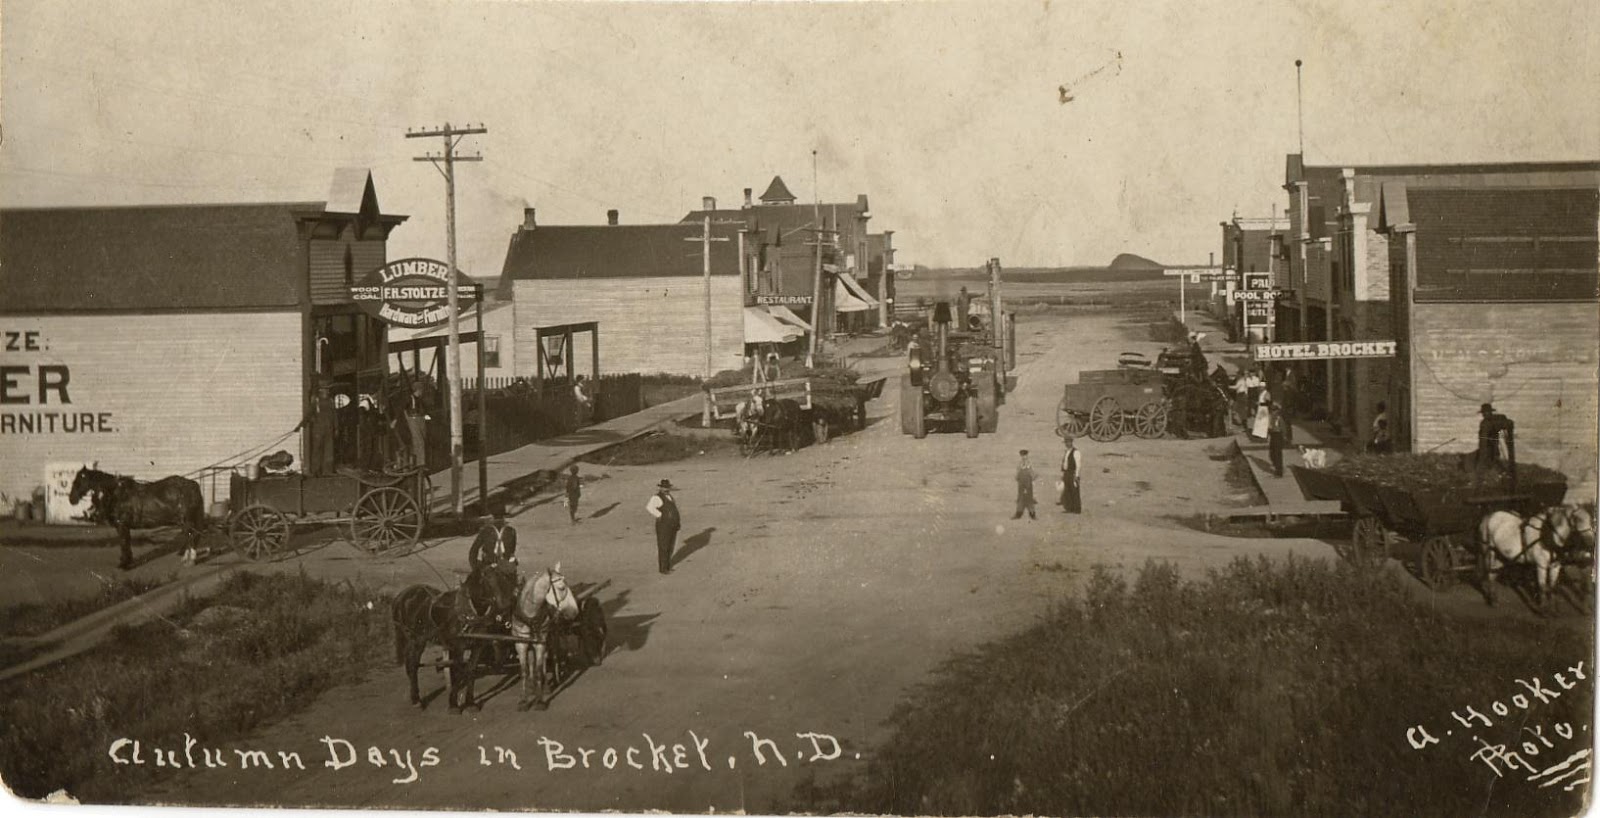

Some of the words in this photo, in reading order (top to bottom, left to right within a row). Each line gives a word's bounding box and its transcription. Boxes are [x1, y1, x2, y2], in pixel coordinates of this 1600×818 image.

[379, 261, 448, 282] LUMBER
[1234, 291, 1260, 299] POOL
[1257, 344, 1315, 359] HOTEL
[1318, 342, 1396, 357] BROCKET
